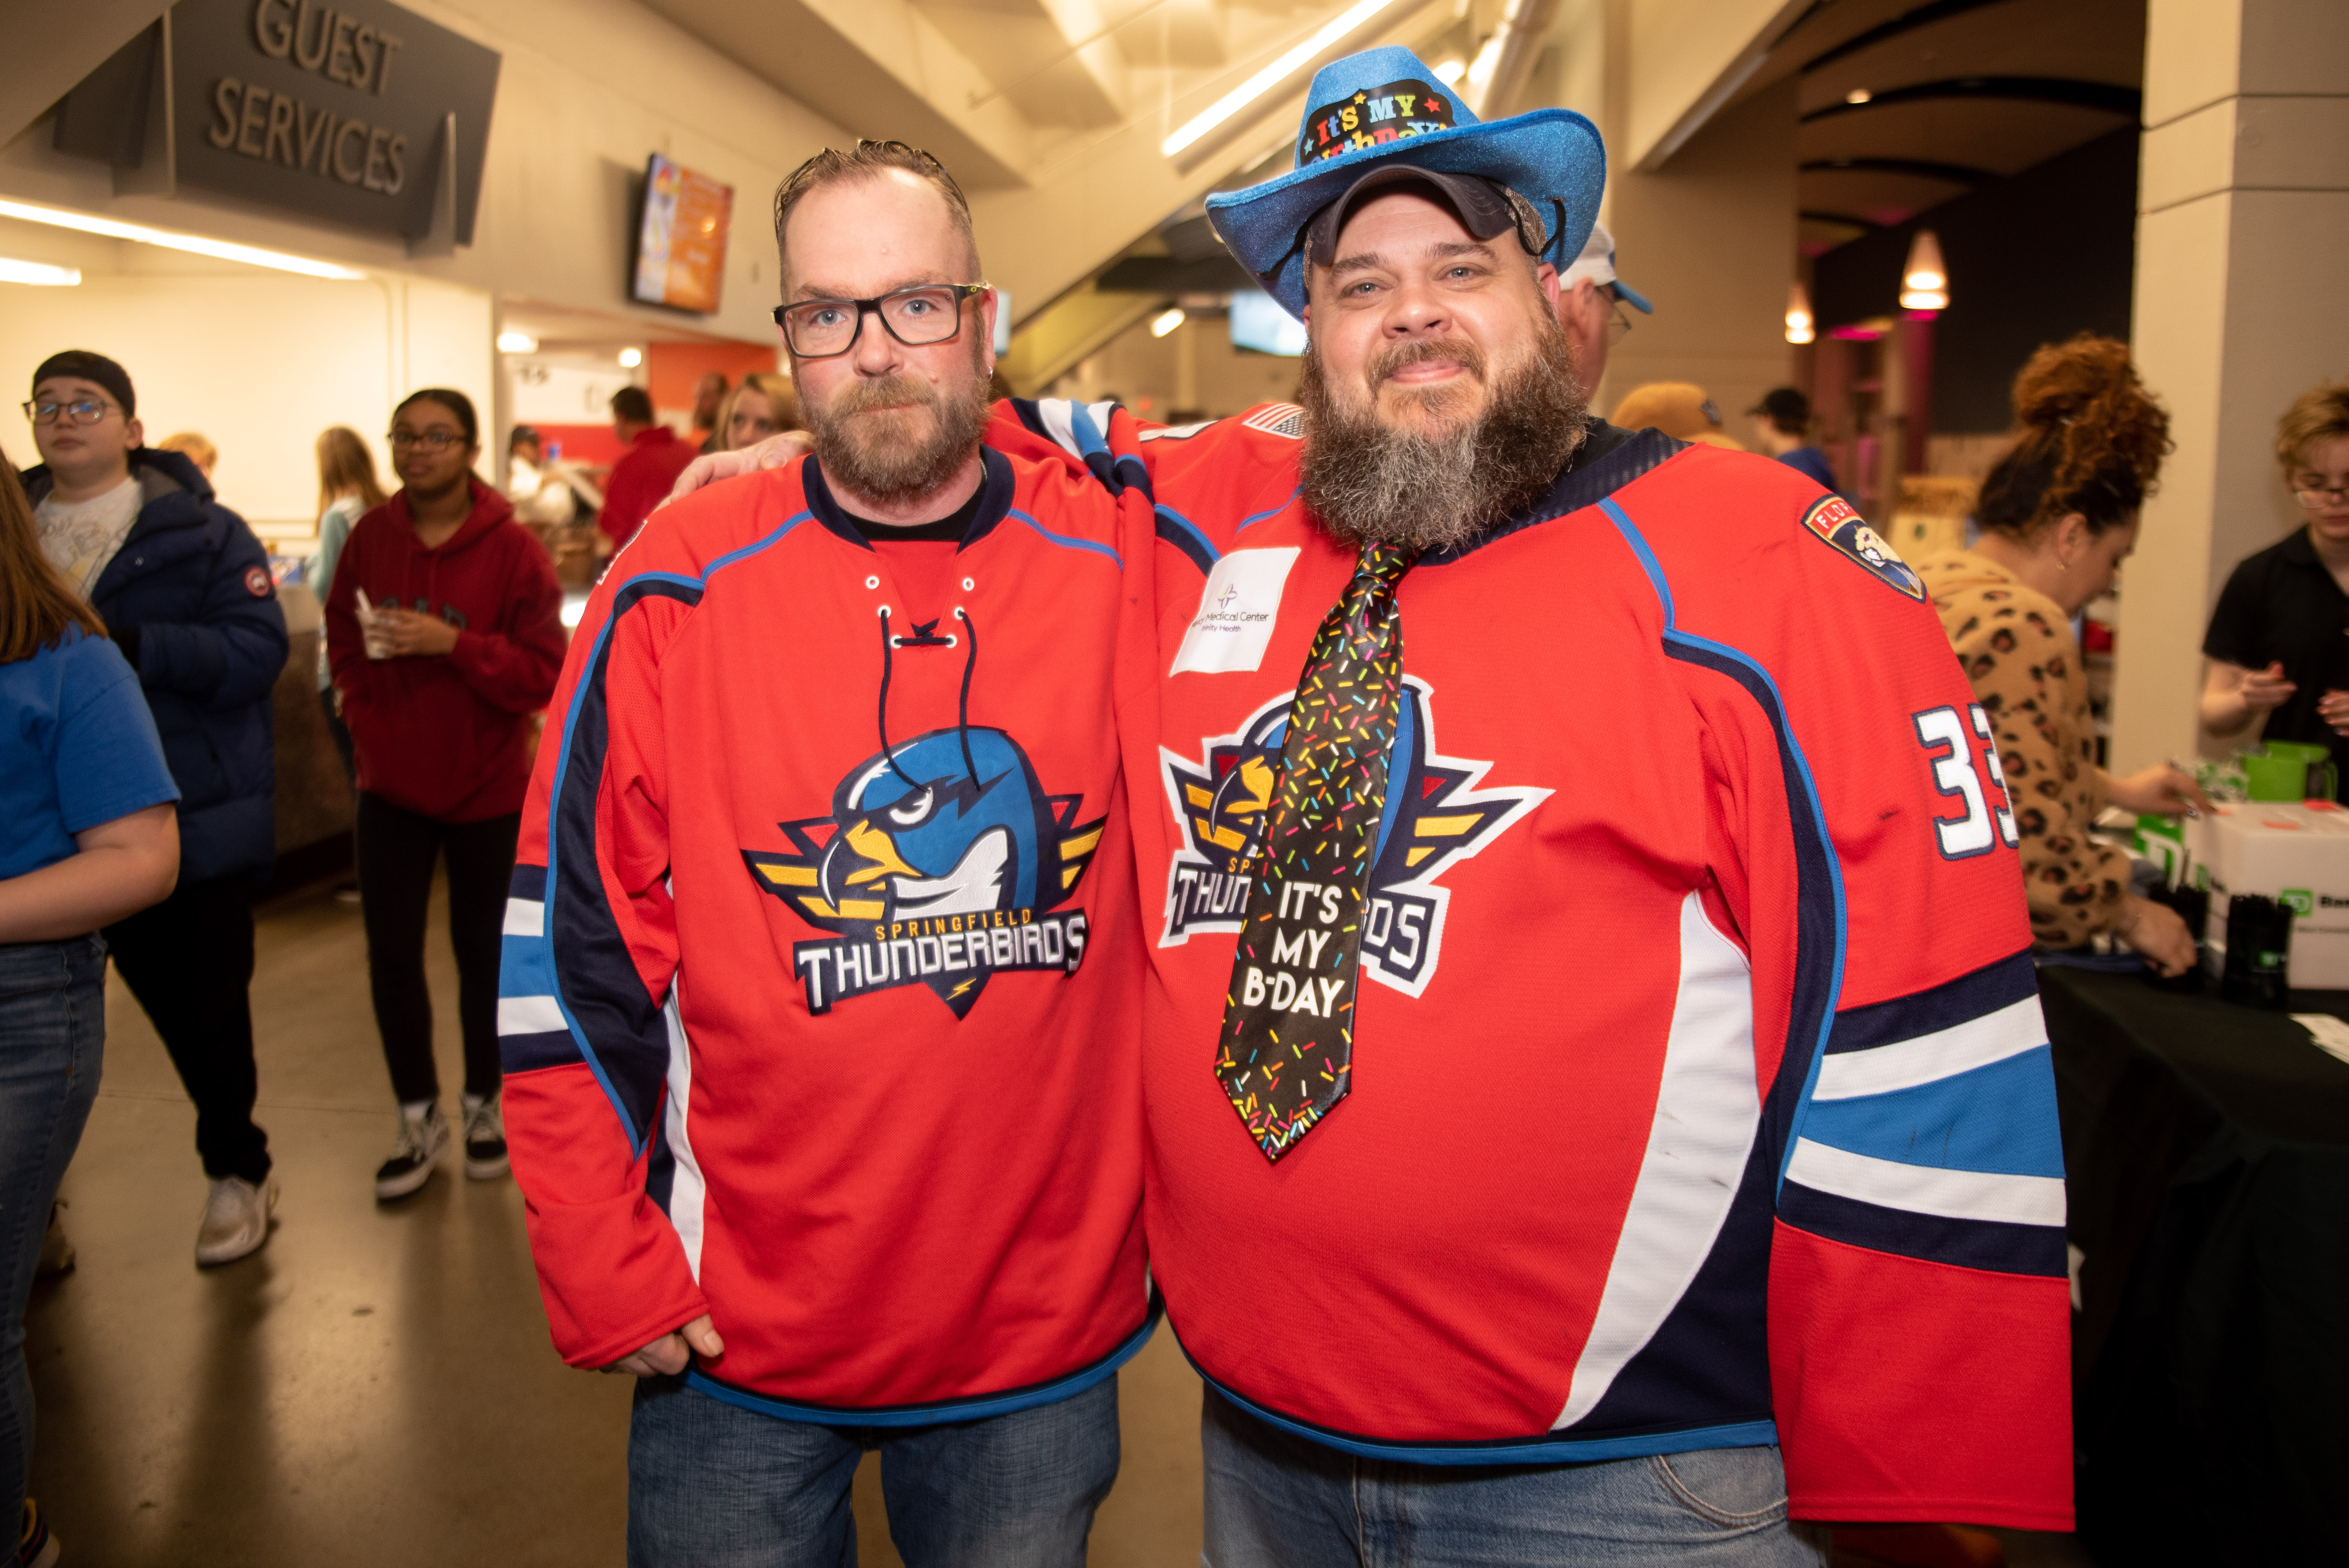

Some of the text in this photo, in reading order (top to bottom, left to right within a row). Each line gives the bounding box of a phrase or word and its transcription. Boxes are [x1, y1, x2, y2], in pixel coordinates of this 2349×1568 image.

[256, 0, 404, 94] GUEST
[1367, 95, 1416, 124] MY
[210, 77, 407, 195] SERVICES
[1201, 624, 1218, 632] Trinity
[1206, 611, 1238, 622] Medical
[1240, 612, 1269, 621] Center
[1279, 881, 1342, 924] IT'S
[875, 909, 1032, 941] SPRINGFIELD
[799, 915, 1086, 1008] THUNDERBIRDS
[1272, 926, 1331, 969] MY
[1243, 966, 1345, 1018] B-DAY
